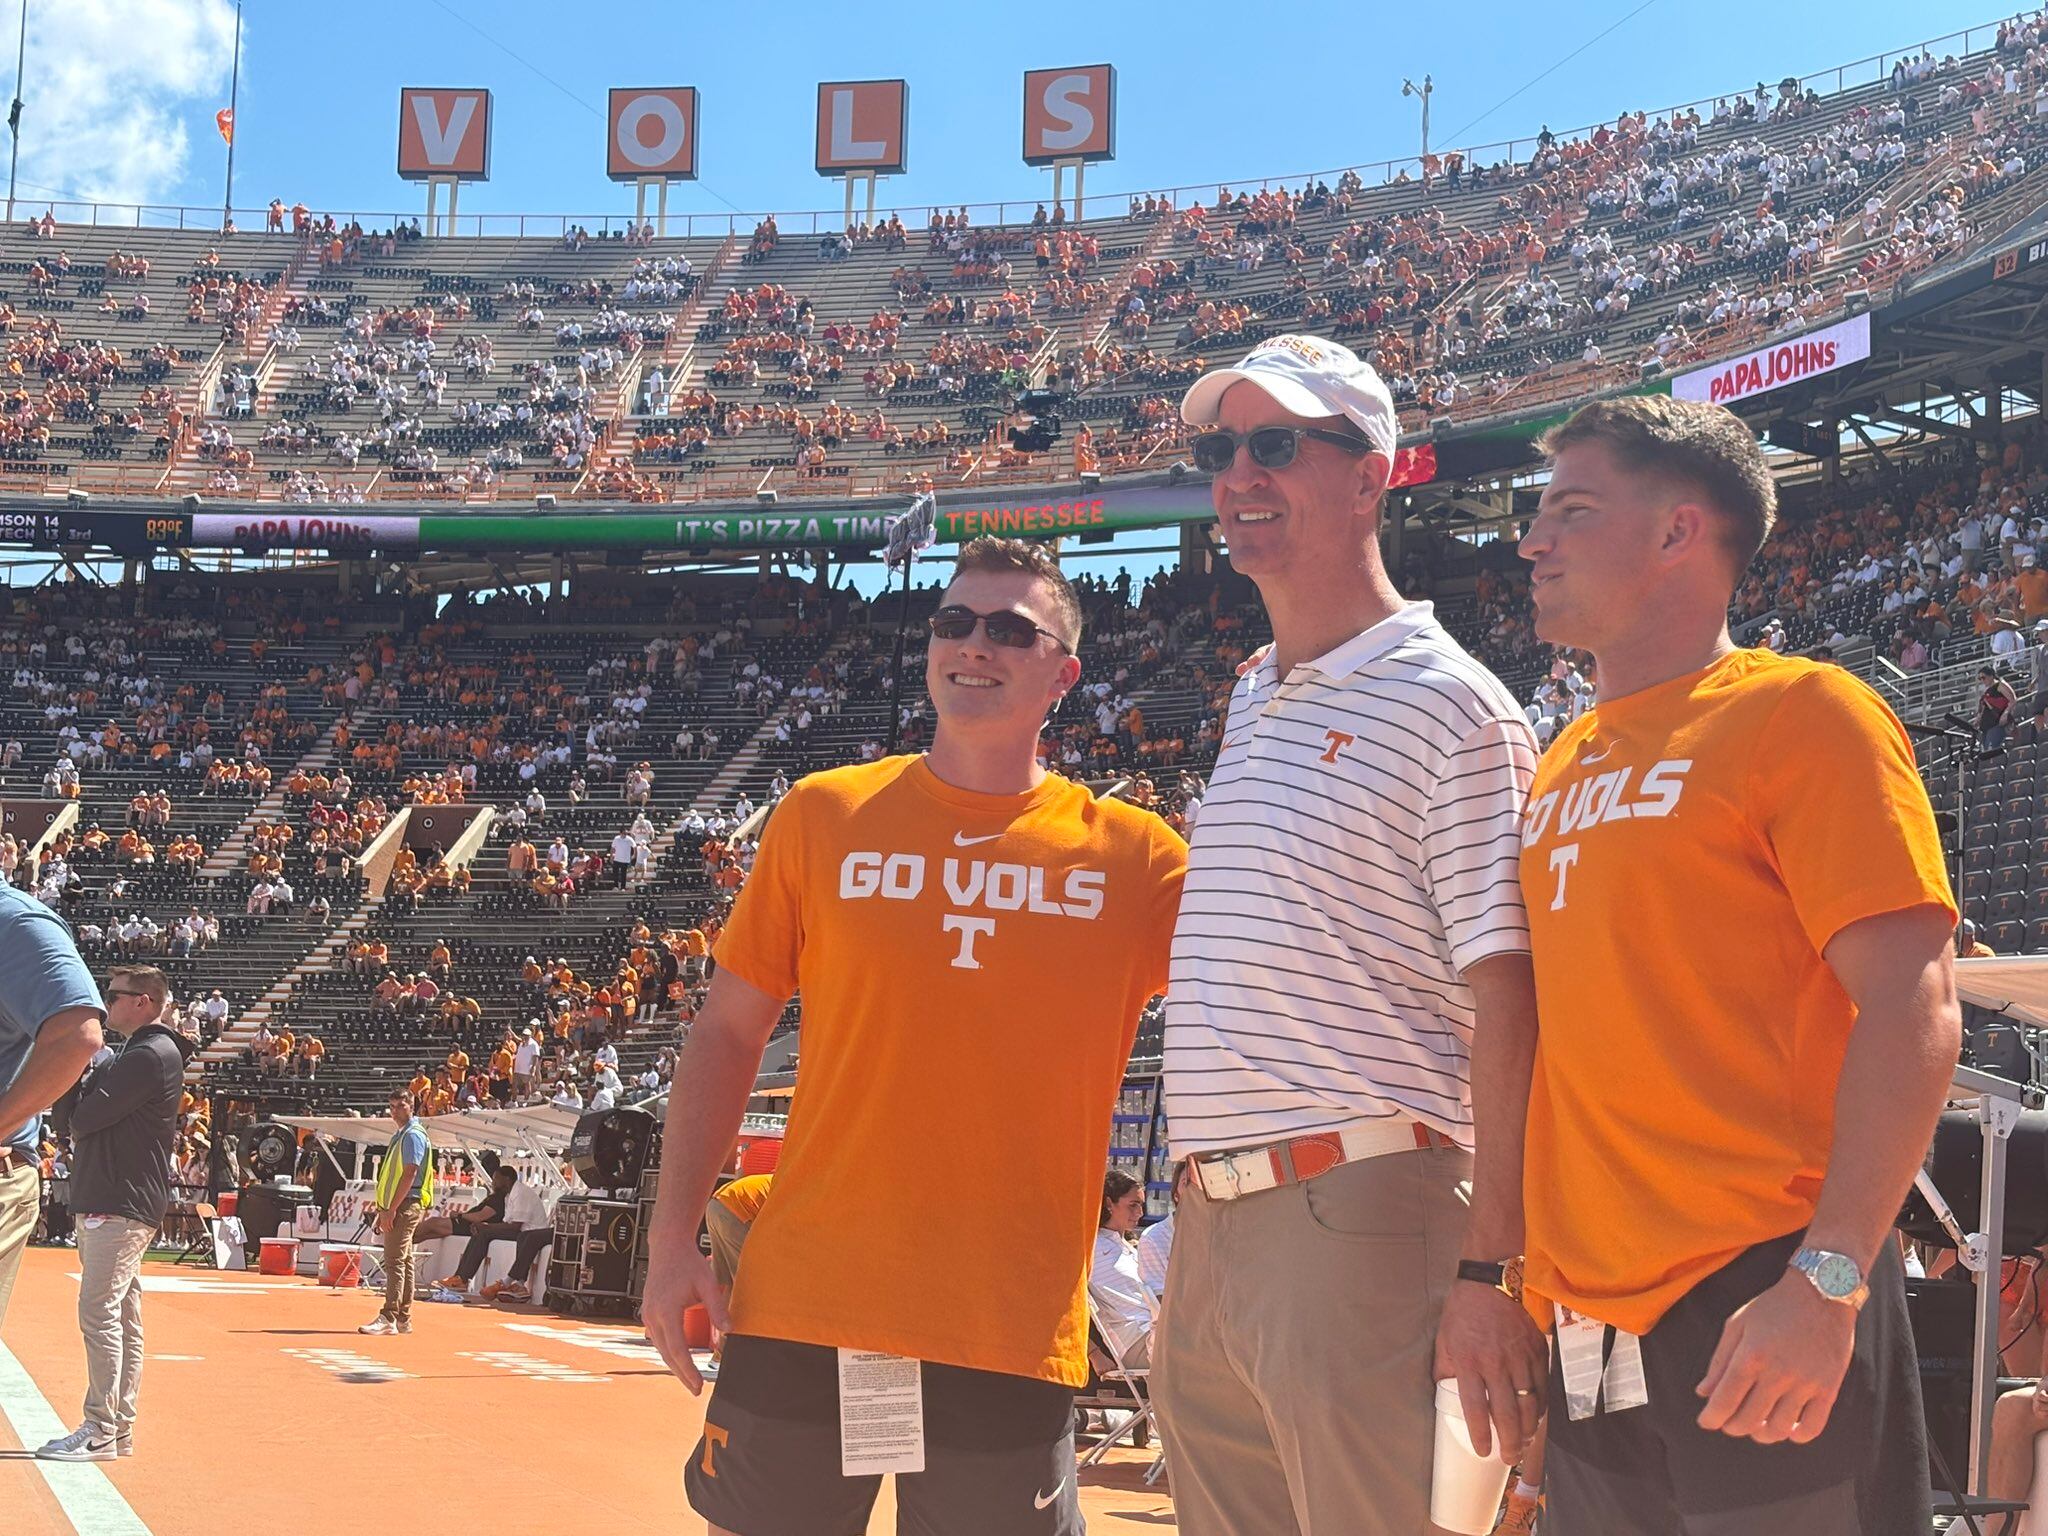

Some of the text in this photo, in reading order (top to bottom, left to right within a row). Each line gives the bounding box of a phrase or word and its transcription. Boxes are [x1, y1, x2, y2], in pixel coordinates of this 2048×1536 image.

[2029, 240, 2048, 263] BI
[1710, 340, 1836, 402] PAPA JOHNS
[44, 516, 60, 527] 14
[44, 529, 60, 540] 13
[68, 529, 92, 540] 3rd
[235, 518, 373, 543] PAPA JOHNS
[738, 518, 823, 543] PIZZA
[945, 500, 1105, 534] TENNESSEE
[1319, 729, 1355, 764] T
[1557, 759, 1693, 836] VOLS
[839, 851, 1106, 920] GO VOLS
[1549, 842, 1579, 912] T
[942, 913, 996, 969] T
[701, 1420, 729, 1478] T
